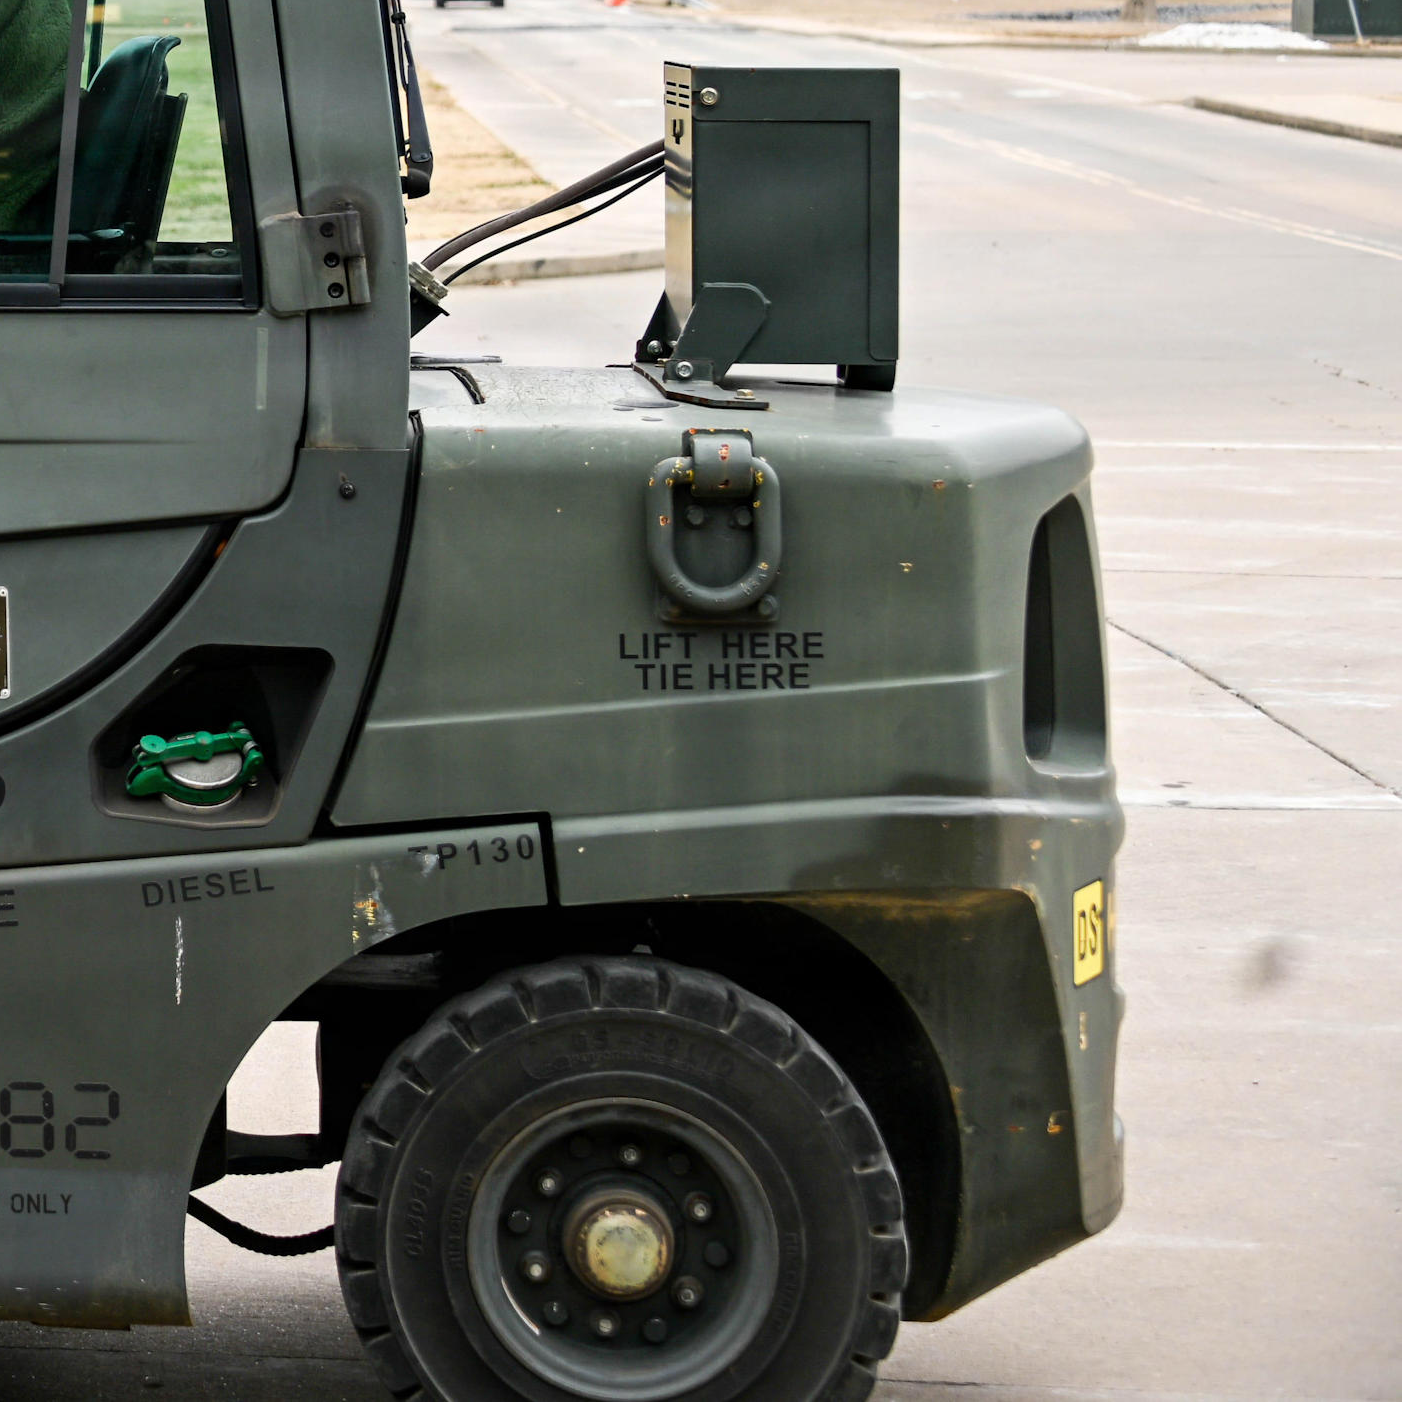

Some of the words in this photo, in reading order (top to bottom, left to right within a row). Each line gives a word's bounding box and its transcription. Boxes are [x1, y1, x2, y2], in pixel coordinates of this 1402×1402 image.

[619, 632, 697, 659] LIFT
[721, 632, 824, 659] HERE
[634, 663, 693, 690] TIE
[708, 663, 810, 690] HERE
[141, 867, 275, 908] DIESEL
[10, 1193, 73, 1215] ONLY
